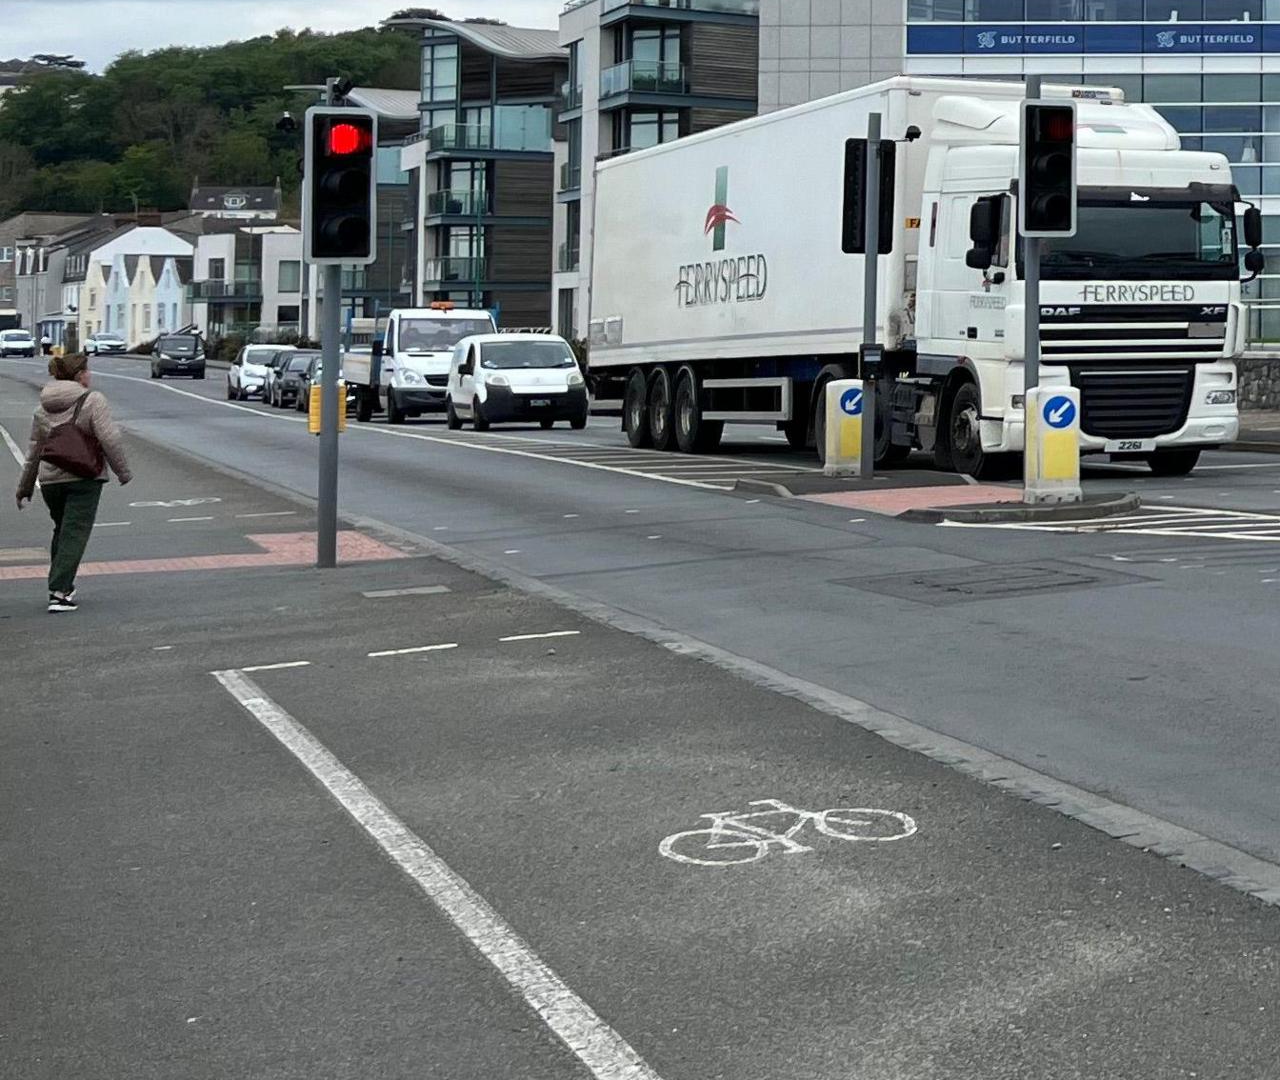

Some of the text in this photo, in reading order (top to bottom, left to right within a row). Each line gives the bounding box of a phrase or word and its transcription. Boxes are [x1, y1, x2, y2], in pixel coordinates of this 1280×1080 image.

[1001, 34, 1075, 45] BUTTERFIELD
[1180, 34, 1254, 44] BUTTERFIELD
[674, 253, 768, 308] FERRYSPEED
[1078, 284, 1195, 302] FERRYSPEED
[1041, 306, 1227, 317] DAF XF
